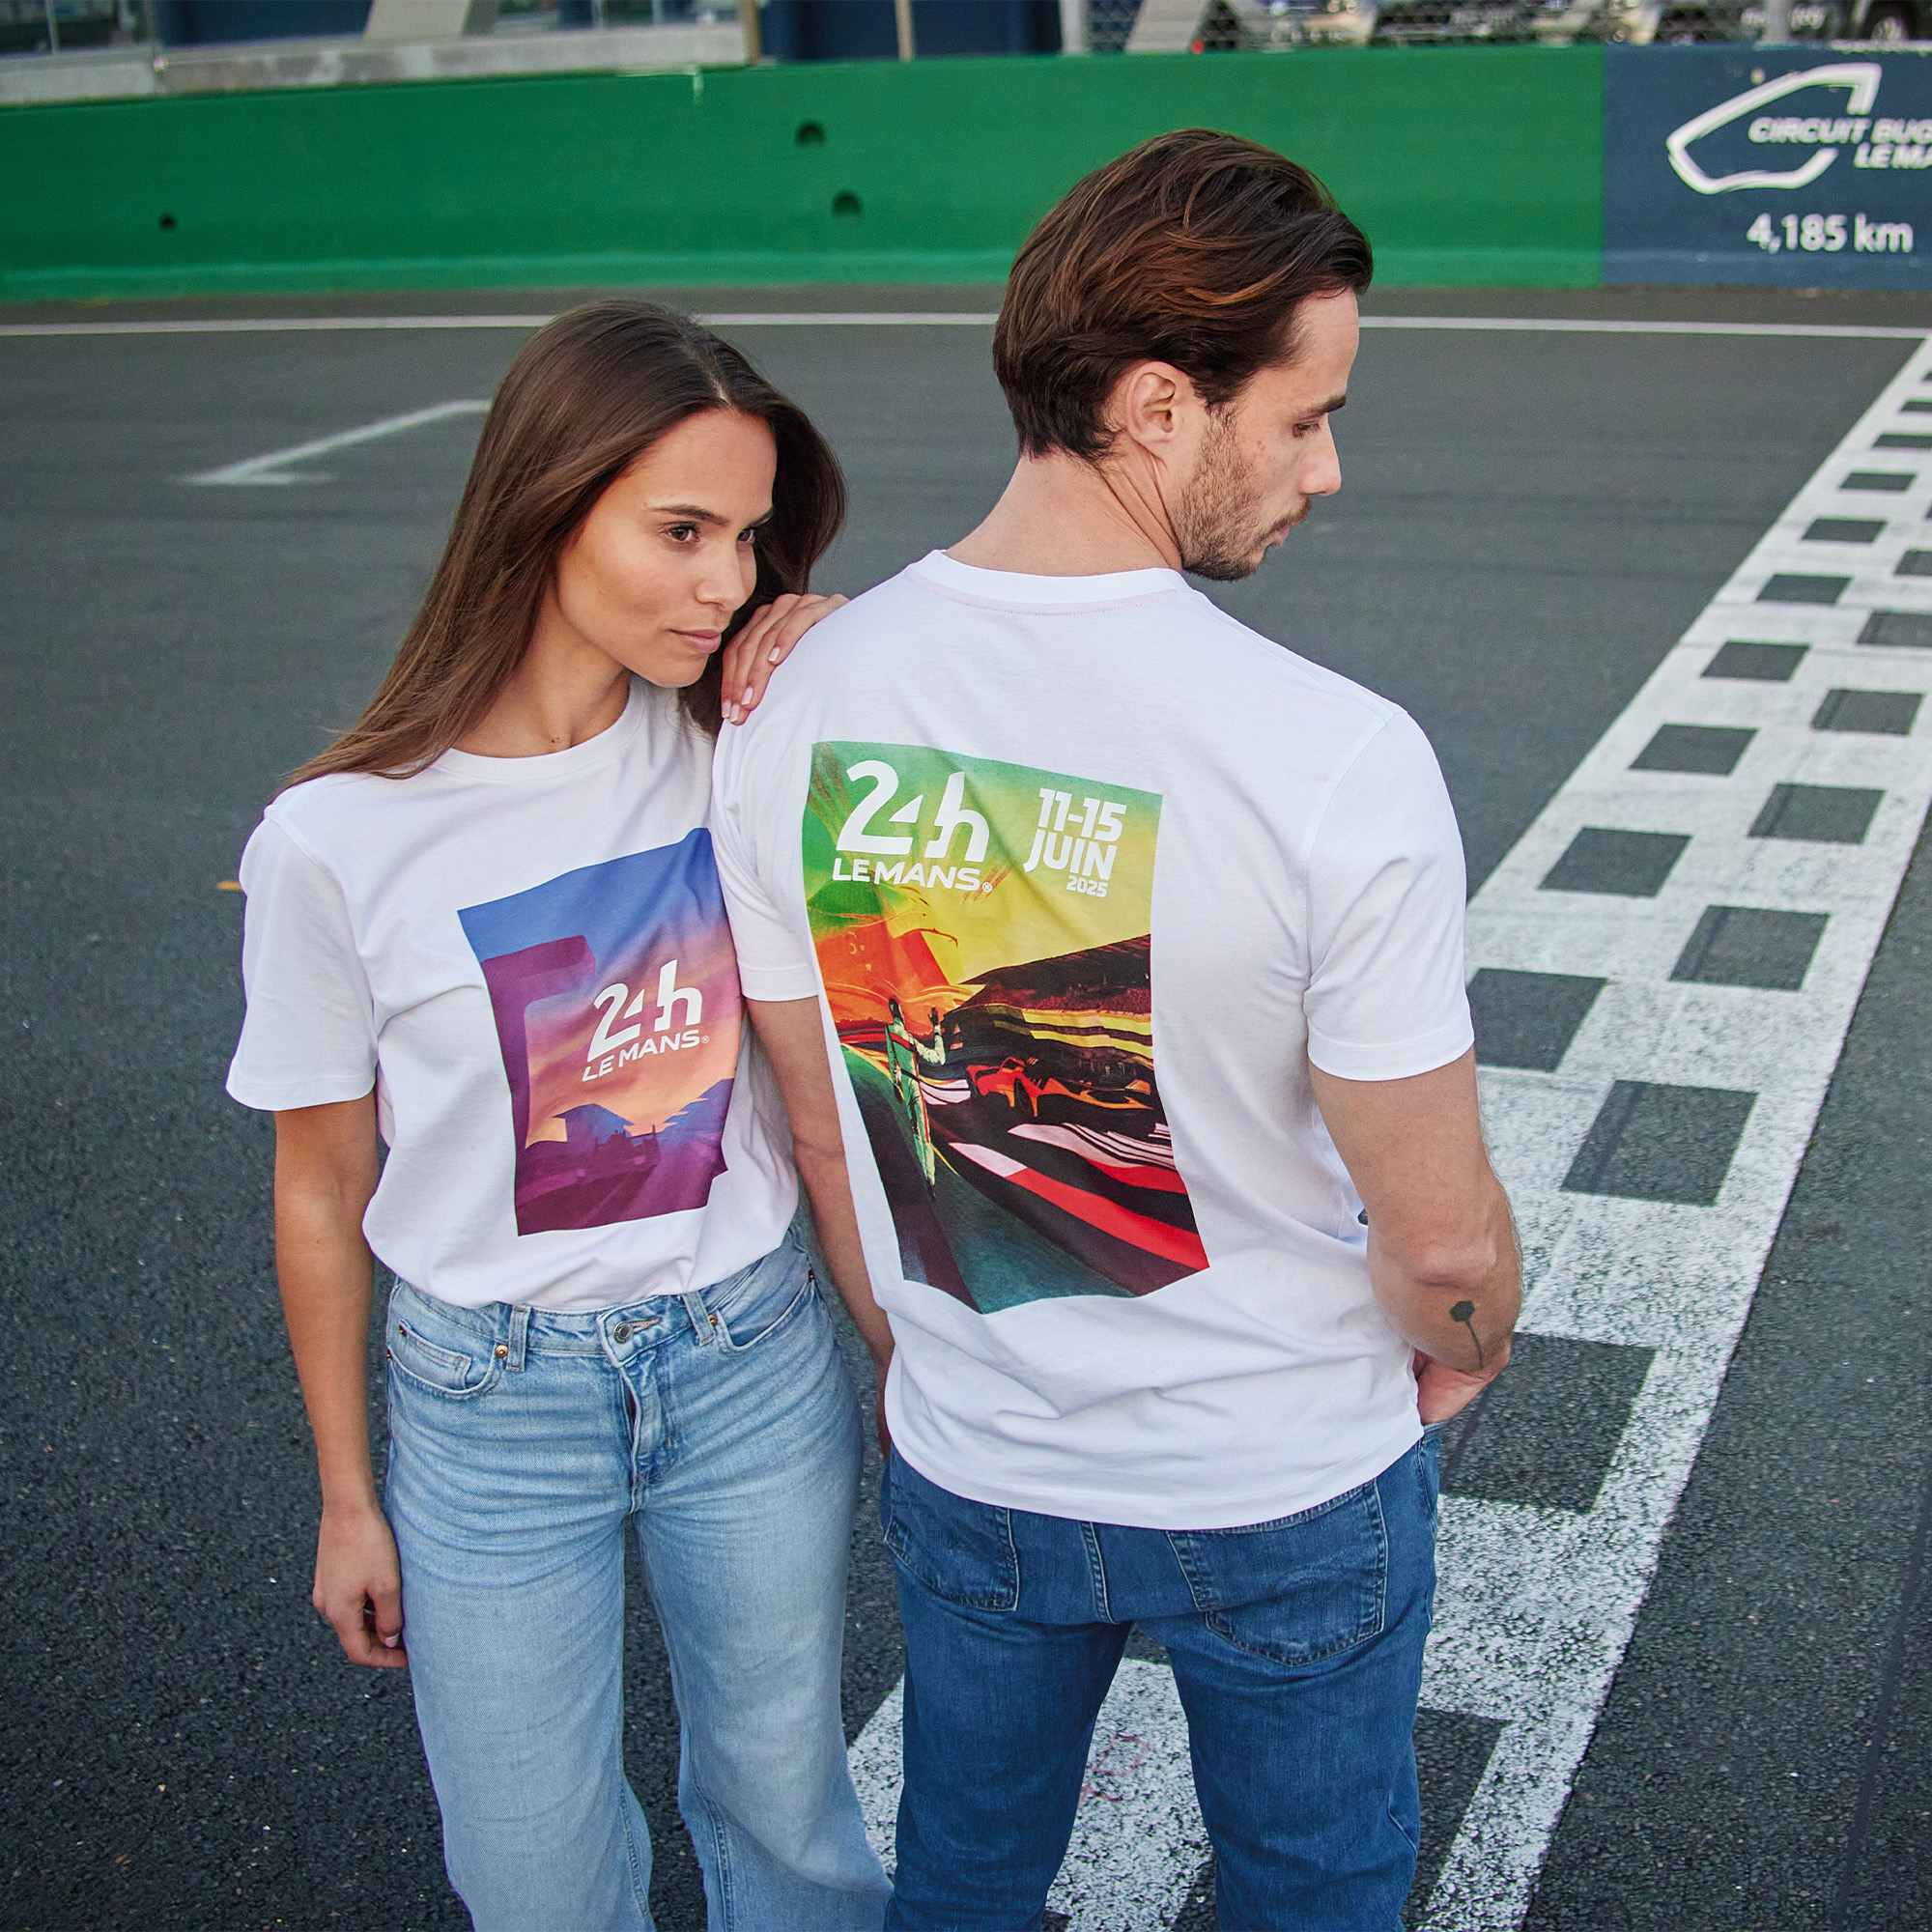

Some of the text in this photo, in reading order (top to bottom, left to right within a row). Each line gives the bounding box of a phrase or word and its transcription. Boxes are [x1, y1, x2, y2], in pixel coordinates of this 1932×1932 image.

[1749, 117, 1871, 143] CIRCUIT
[1854, 144, 1893, 168] LE
[1747, 213, 1914, 254] 4,185 km
[1037, 787, 1127, 842] 11-15
[1022, 830, 1117, 880] JUIN
[1065, 875, 1107, 897] 2025
[582, 1055, 615, 1082] LE
